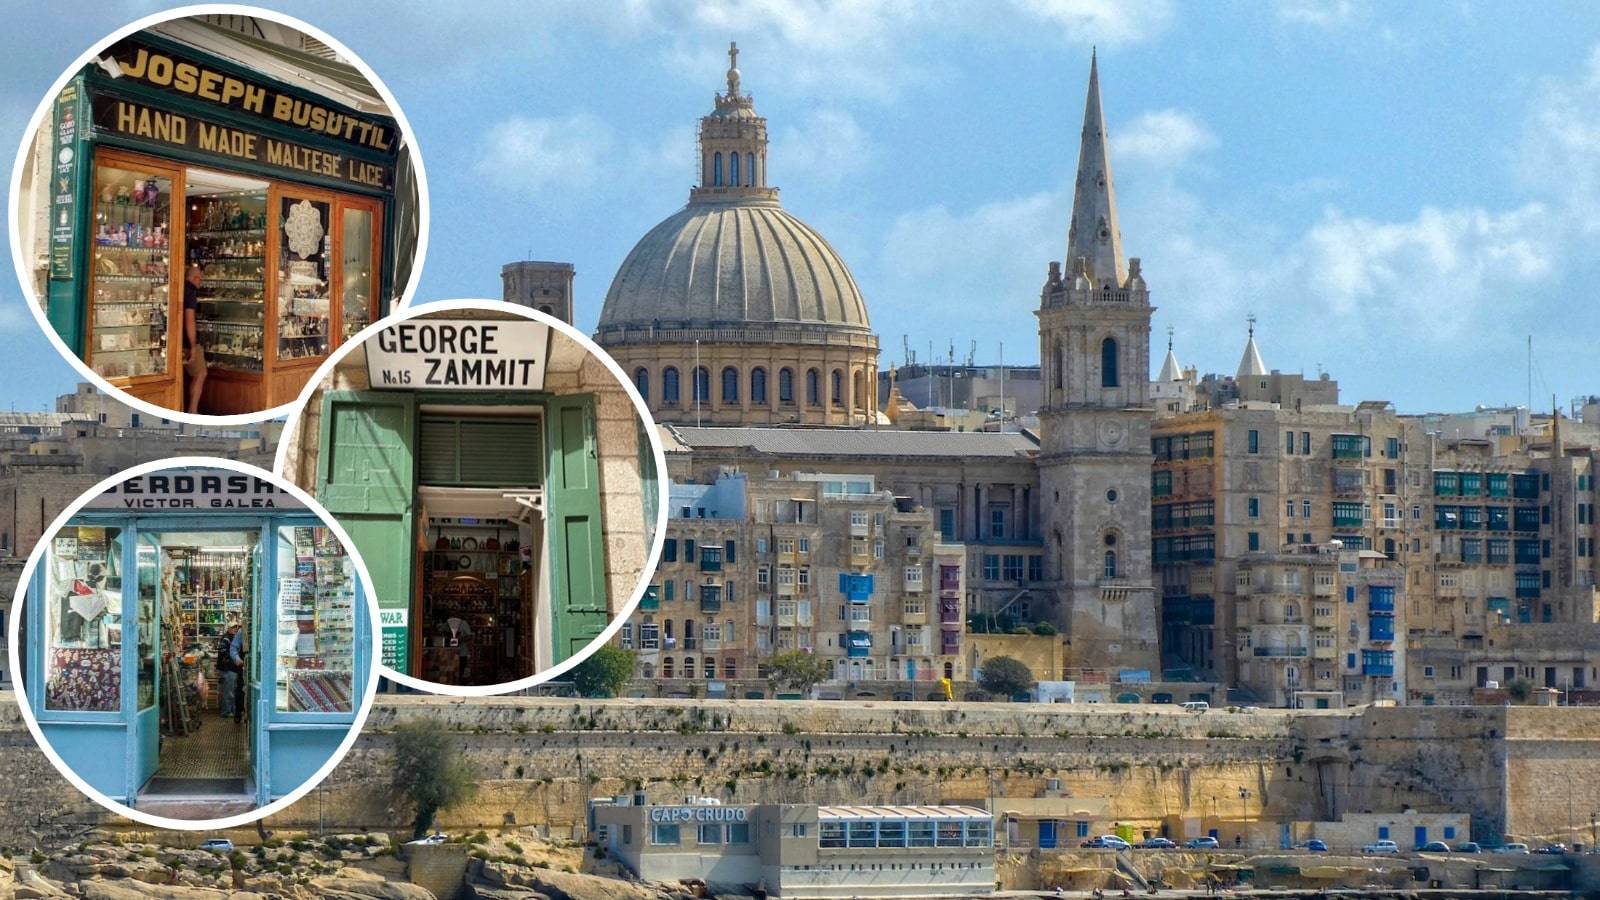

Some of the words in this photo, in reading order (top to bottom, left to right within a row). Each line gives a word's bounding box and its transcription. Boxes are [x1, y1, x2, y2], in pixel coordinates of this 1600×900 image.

[120, 49, 266, 113] JOSEPH
[272, 94, 391, 150] BUSUTTIL
[117, 102, 187, 146] HAND
[199, 122, 258, 160] MADE
[266, 138, 342, 178] MALTESE
[349, 159, 384, 187] LACE
[378, 325, 498, 354] GEORGE
[424, 358, 535, 386] ZAMMIT
[103, 476, 289, 494] ERDASH
[210, 498, 277, 508] GALEA
[651, 808, 692, 821] CAPO
[696, 808, 746, 821] CRUDO
